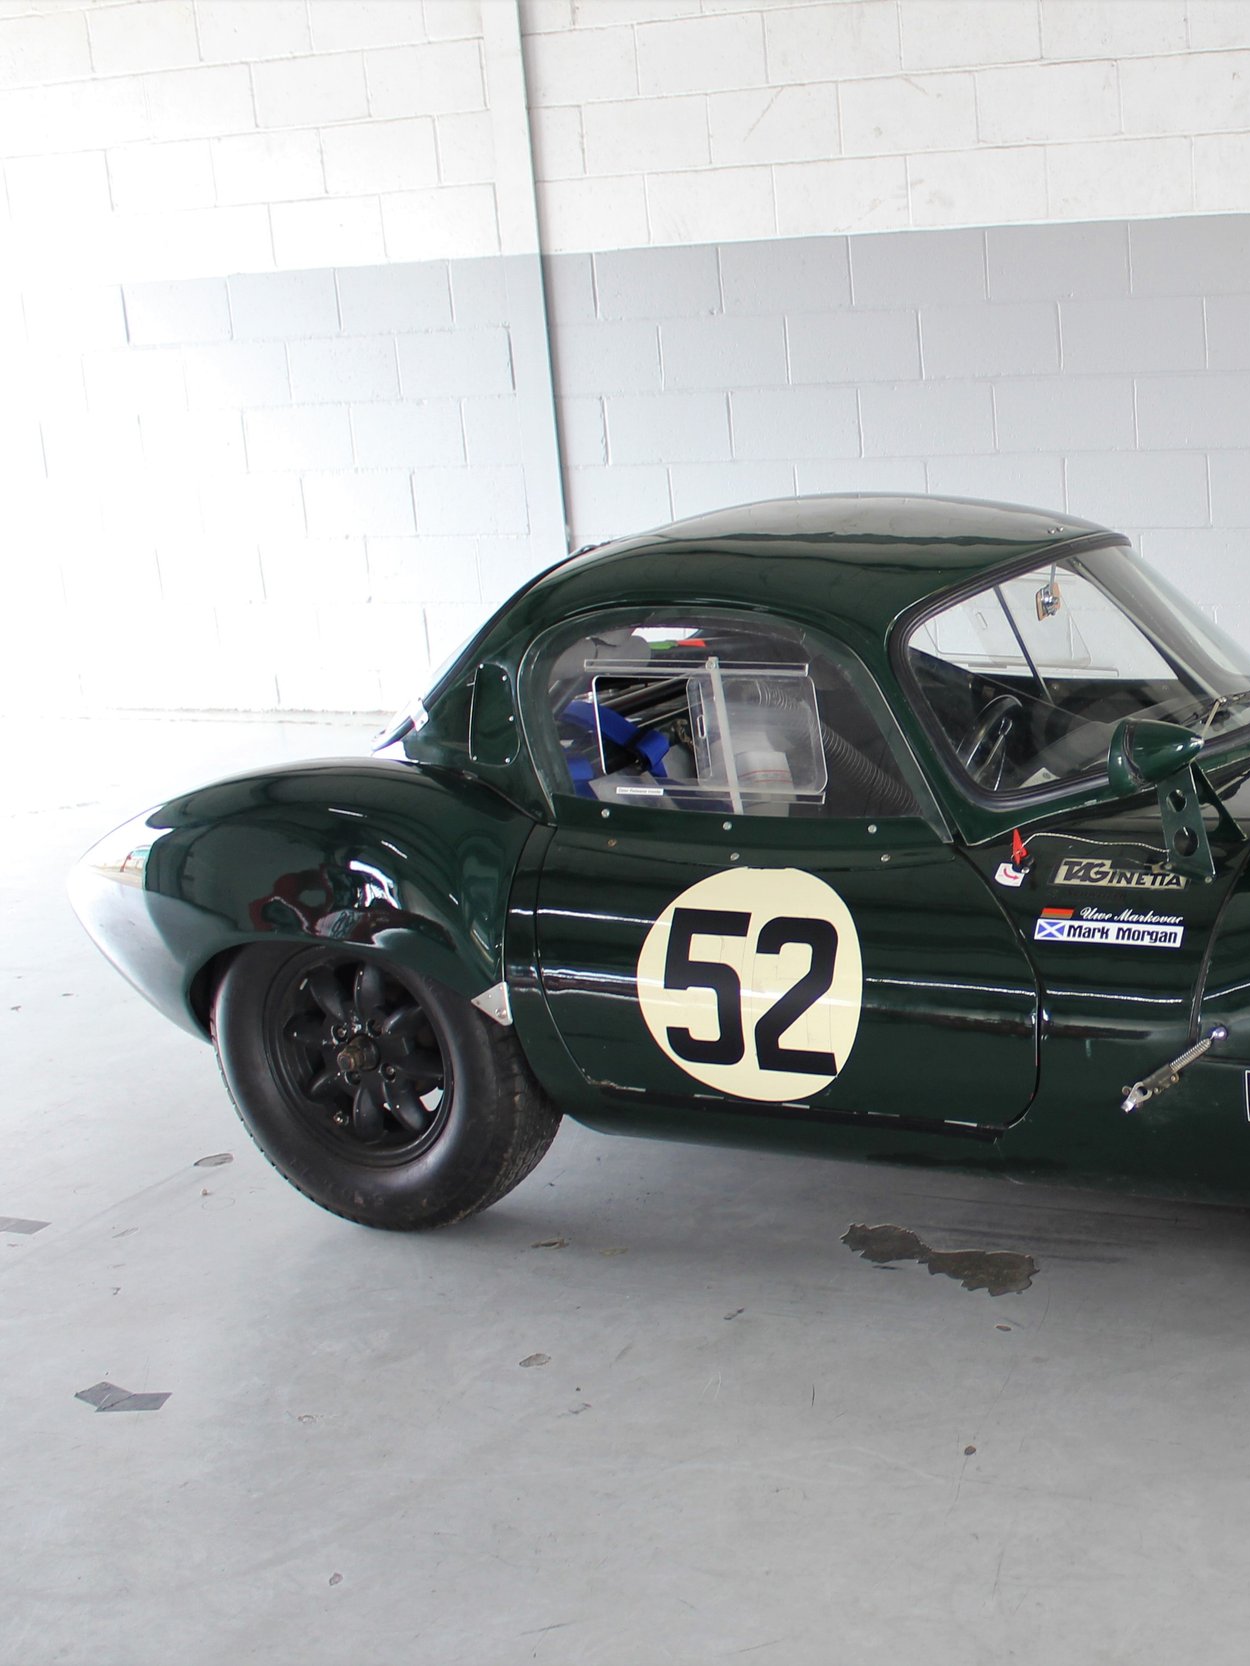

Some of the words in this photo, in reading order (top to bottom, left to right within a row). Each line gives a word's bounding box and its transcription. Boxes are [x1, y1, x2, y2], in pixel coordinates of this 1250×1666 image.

[1080, 907, 1112, 921] Uwe
[1068, 925, 1110, 938] Mark
[1116, 928, 1178, 943] Morgan
[664, 907, 838, 1077] 52
